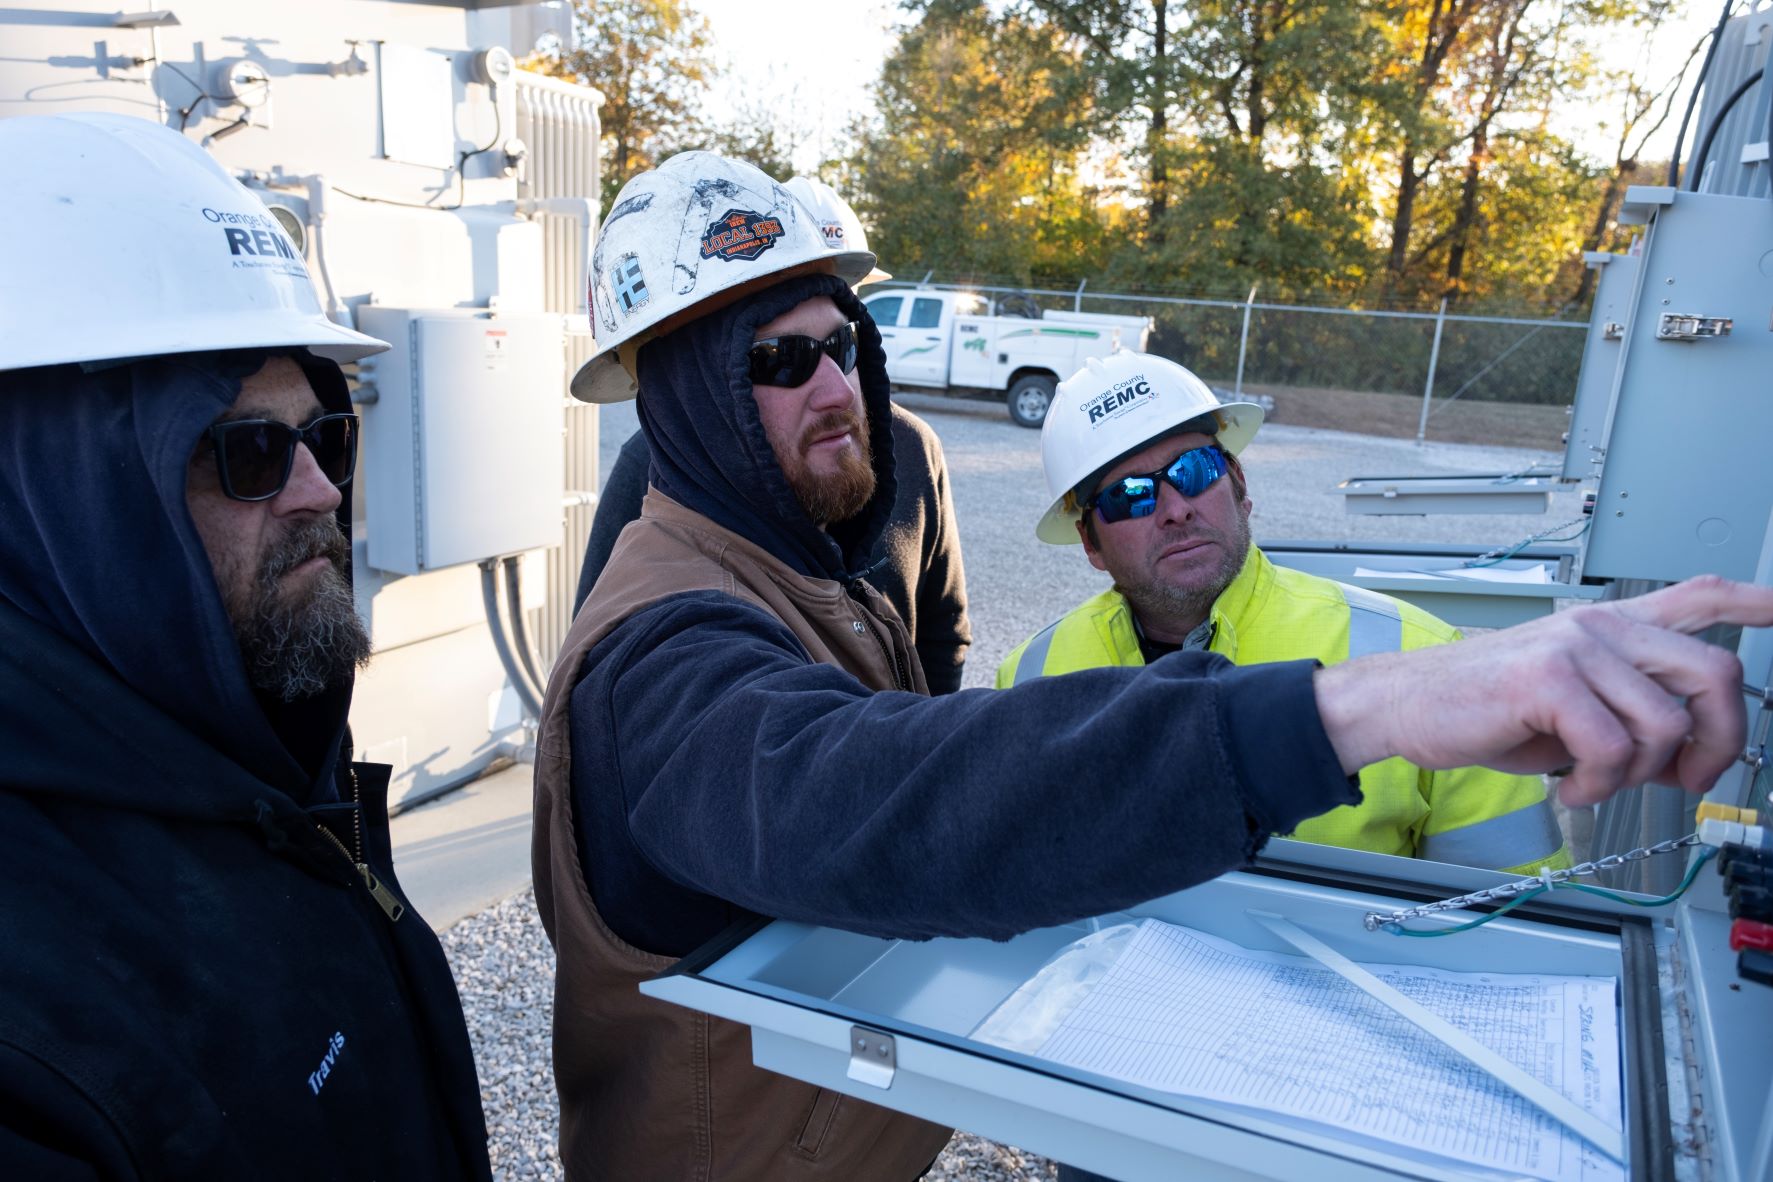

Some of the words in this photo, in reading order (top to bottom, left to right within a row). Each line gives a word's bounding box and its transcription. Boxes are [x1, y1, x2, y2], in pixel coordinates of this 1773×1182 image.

[202, 208, 260, 229] Orange
[821, 226, 844, 239] MC
[224, 228, 295, 260] REM
[703, 226, 755, 255] LOCAL
[1079, 389, 1112, 412] Orange
[1113, 373, 1145, 391] County
[1088, 381, 1151, 424] REMC
[308, 1031, 345, 1095] Travis
